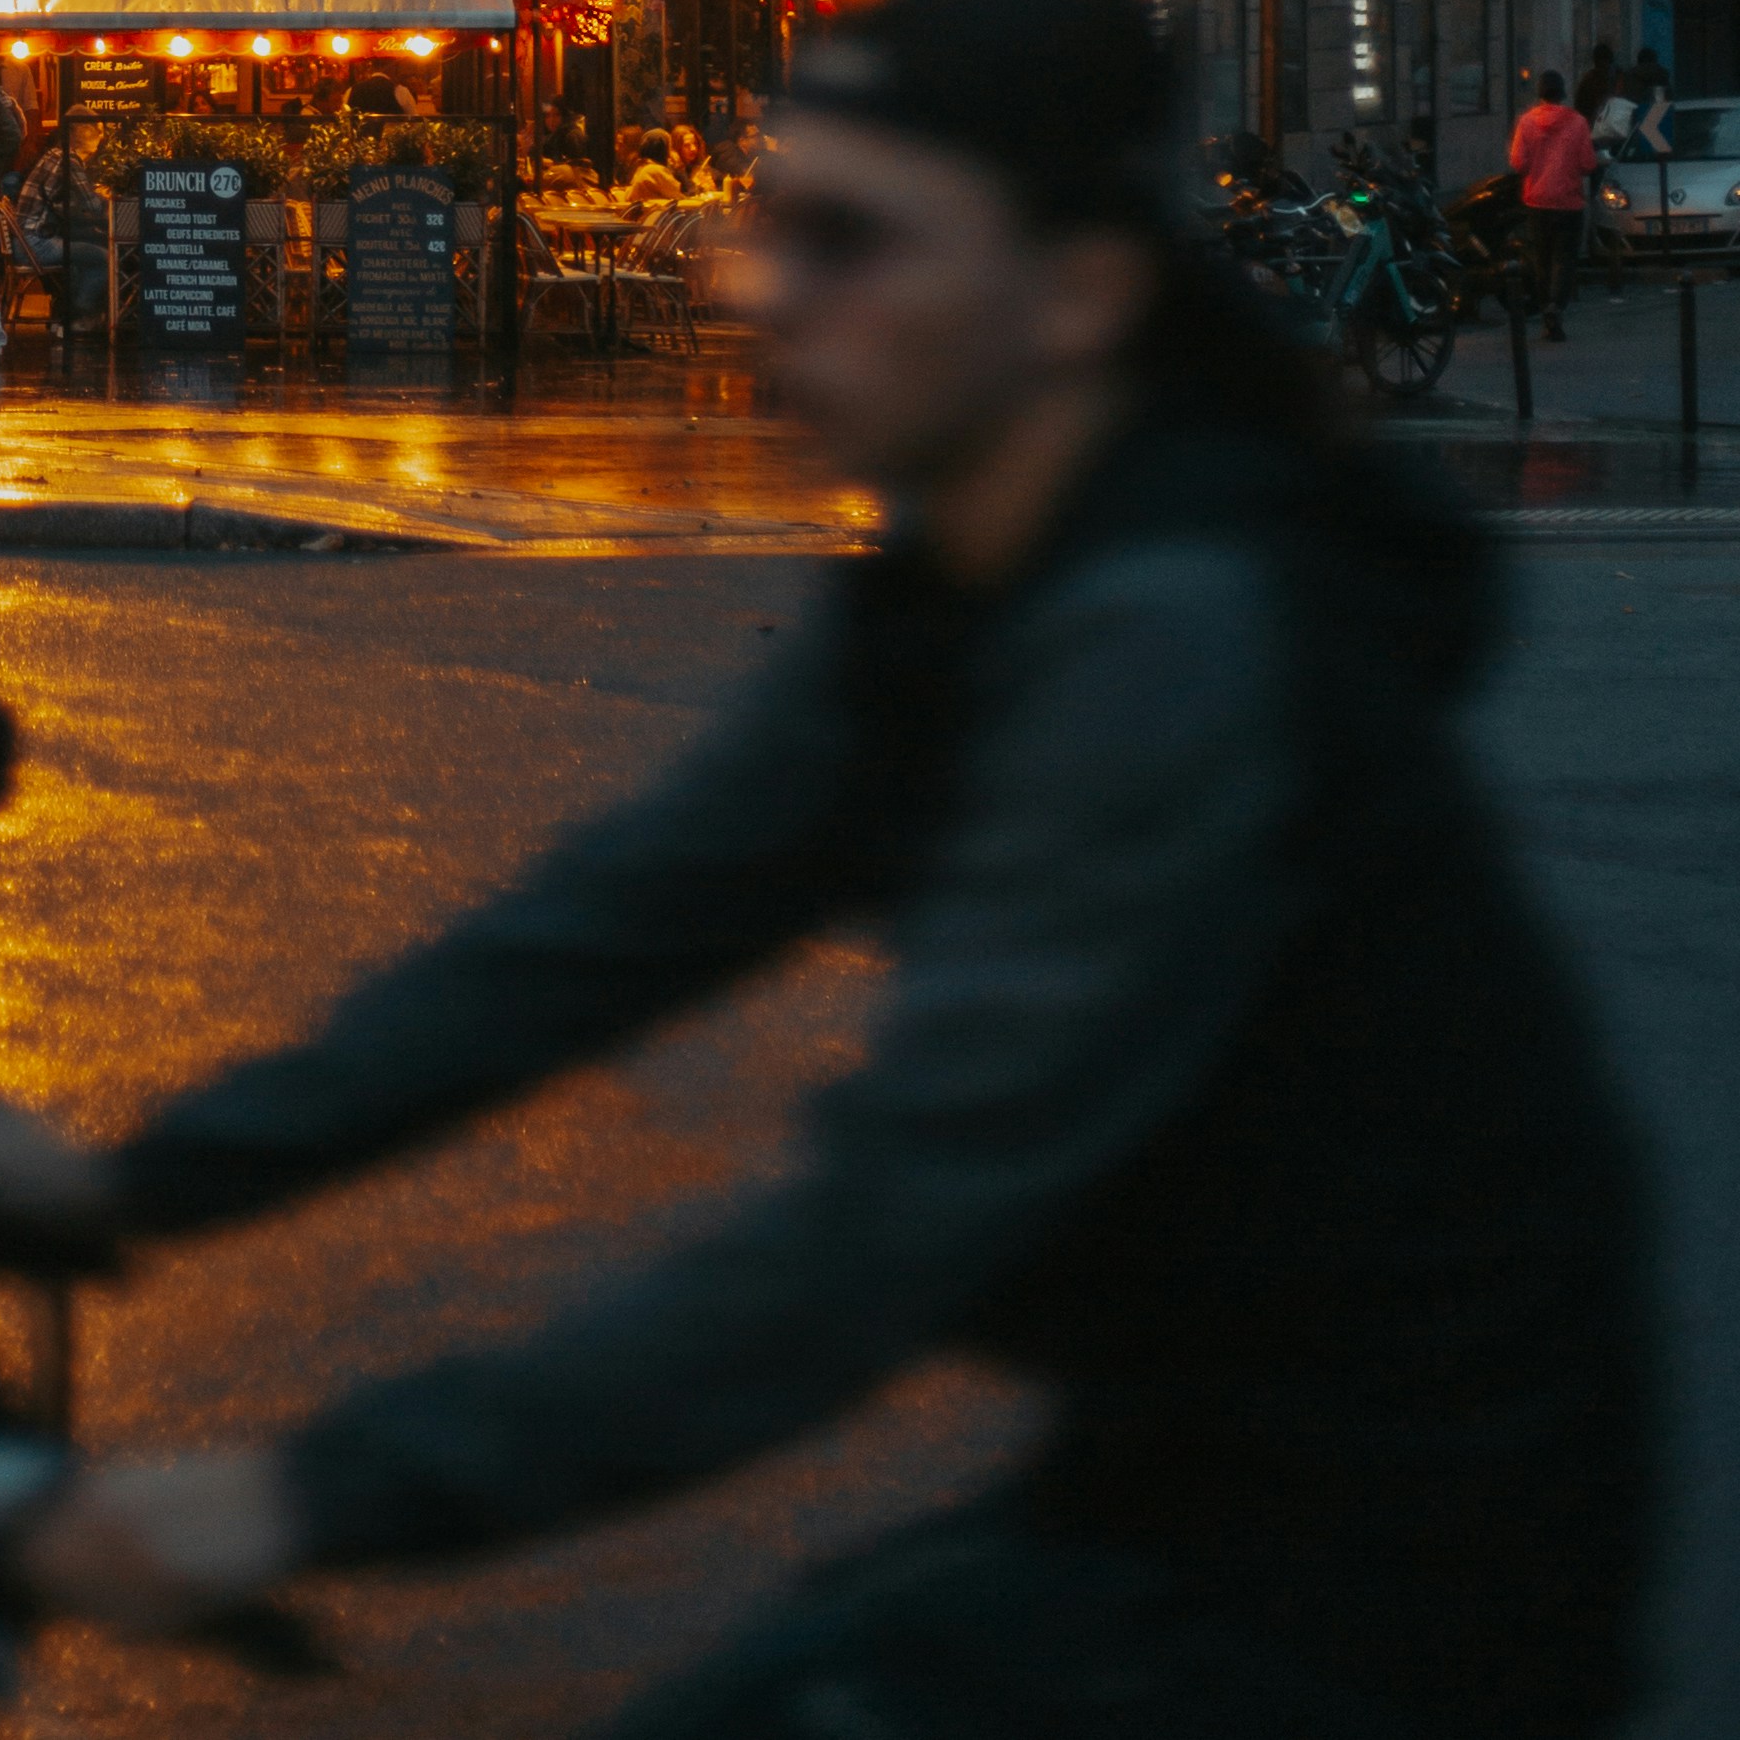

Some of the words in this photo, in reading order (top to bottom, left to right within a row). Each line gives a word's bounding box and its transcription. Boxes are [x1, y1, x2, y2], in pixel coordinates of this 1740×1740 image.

[84, 100, 115, 111] TARTE
[145, 170, 206, 193] BRUNCH
[213, 174, 240, 191] 27€
[351, 175, 390, 203] MENU
[394, 174, 455, 206] PLANCHES
[144, 197, 187, 210] PANCAKES
[154, 213, 192, 225] AVOCADO
[192, 214, 218, 225] TOAST
[144, 243, 204, 255] COCO/NUTELLA
[156, 258, 230, 271] BANANE/CARAMEL
[166, 274, 198, 286] FRENCH
[144, 289, 169, 300] LATTE
[216, 304, 237, 317] CAFÉ
[166, 319, 186, 332] CAFÉ
[187, 320, 211, 332] MOKA
